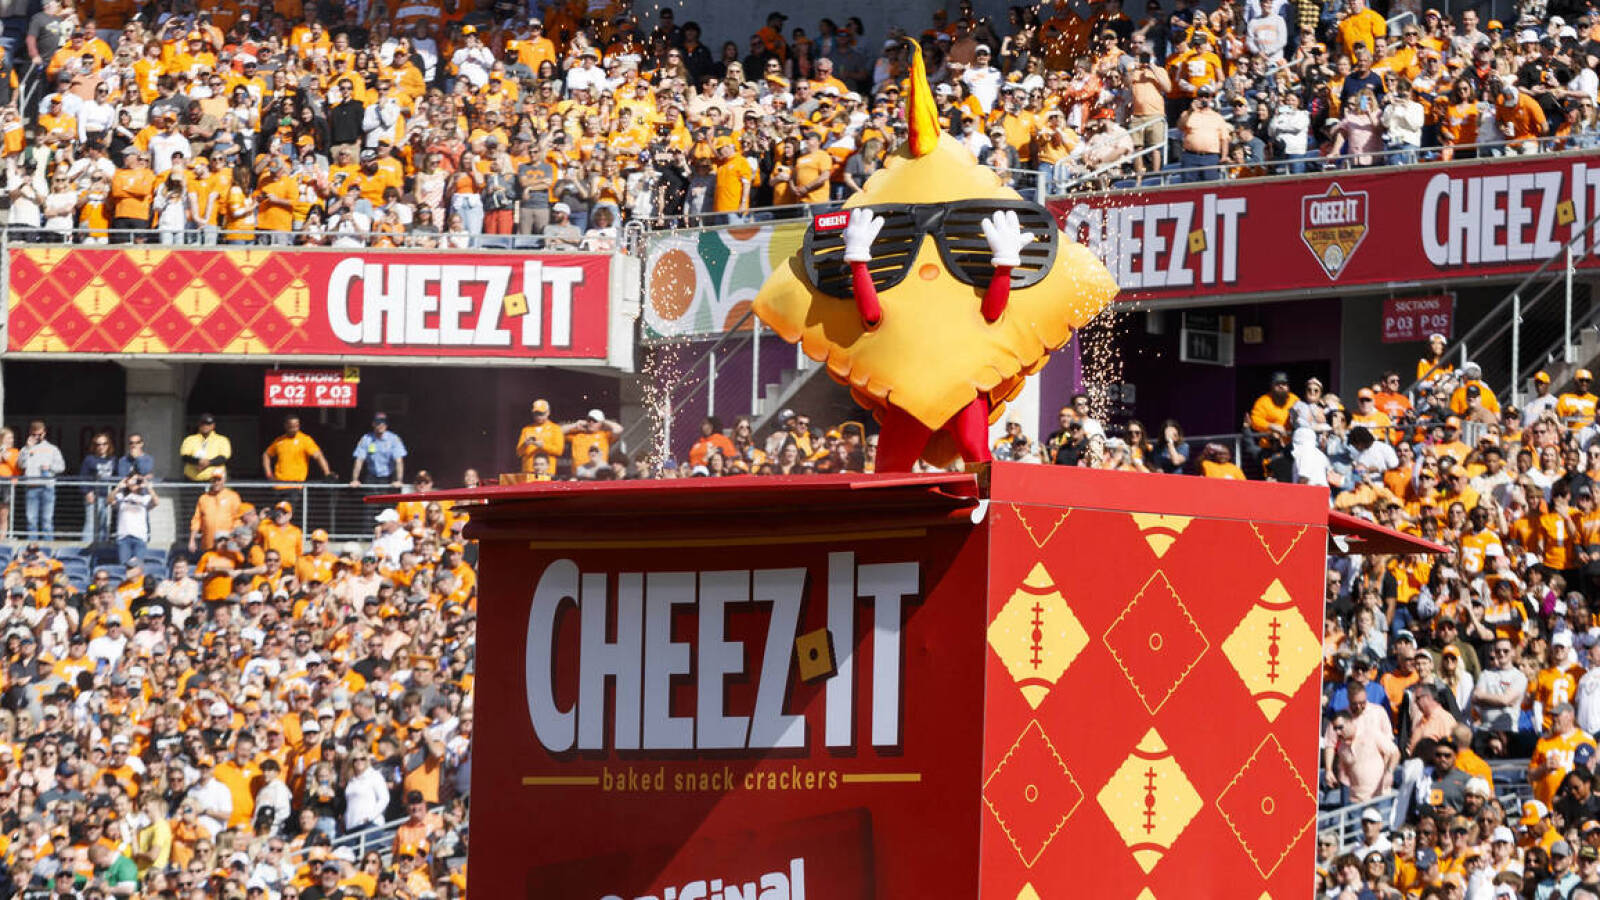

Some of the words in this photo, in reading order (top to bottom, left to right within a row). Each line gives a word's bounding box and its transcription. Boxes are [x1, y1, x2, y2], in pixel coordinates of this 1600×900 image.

[1386, 317, 1394, 331] P
[1397, 316, 1413, 330] 03
[1421, 314, 1429, 327] P
[1431, 313, 1448, 327] 05
[281, 373, 341, 383] SECTIONS
[269, 385, 281, 398] P
[284, 385, 306, 398] 02
[315, 385, 327, 398] P
[330, 385, 351, 398] 03
[1553, 678, 1569, 704] 6
[602, 766, 664, 791] baked
[674, 766, 735, 791] snack
[744, 764, 838, 790] crackers
